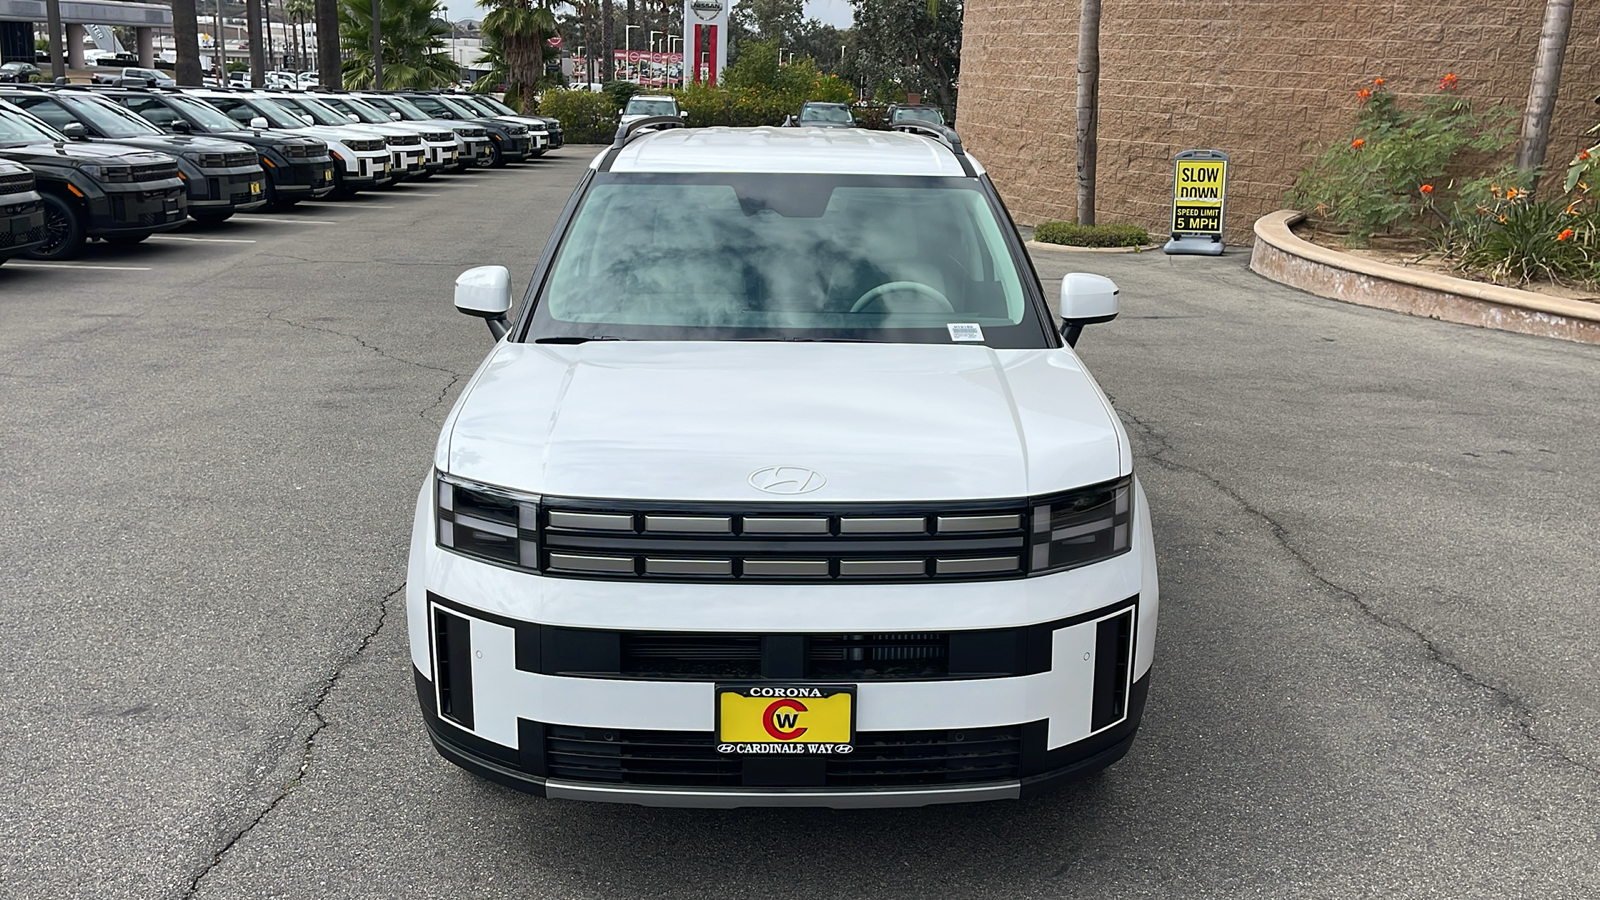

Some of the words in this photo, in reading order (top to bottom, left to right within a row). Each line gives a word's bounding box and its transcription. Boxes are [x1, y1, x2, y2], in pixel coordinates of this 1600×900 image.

[1181, 167, 1219, 182] SLOW
[1181, 186, 1218, 198] DOWN
[1177, 208, 1199, 216] SPEED
[1200, 209, 1219, 217] LIMIT
[1177, 218, 1185, 228] 5
[1189, 218, 1218, 229] MPH
[750, 687, 822, 697] CORONA
[736, 743, 805, 754] CARDINALE
[808, 743, 834, 754] WAY
